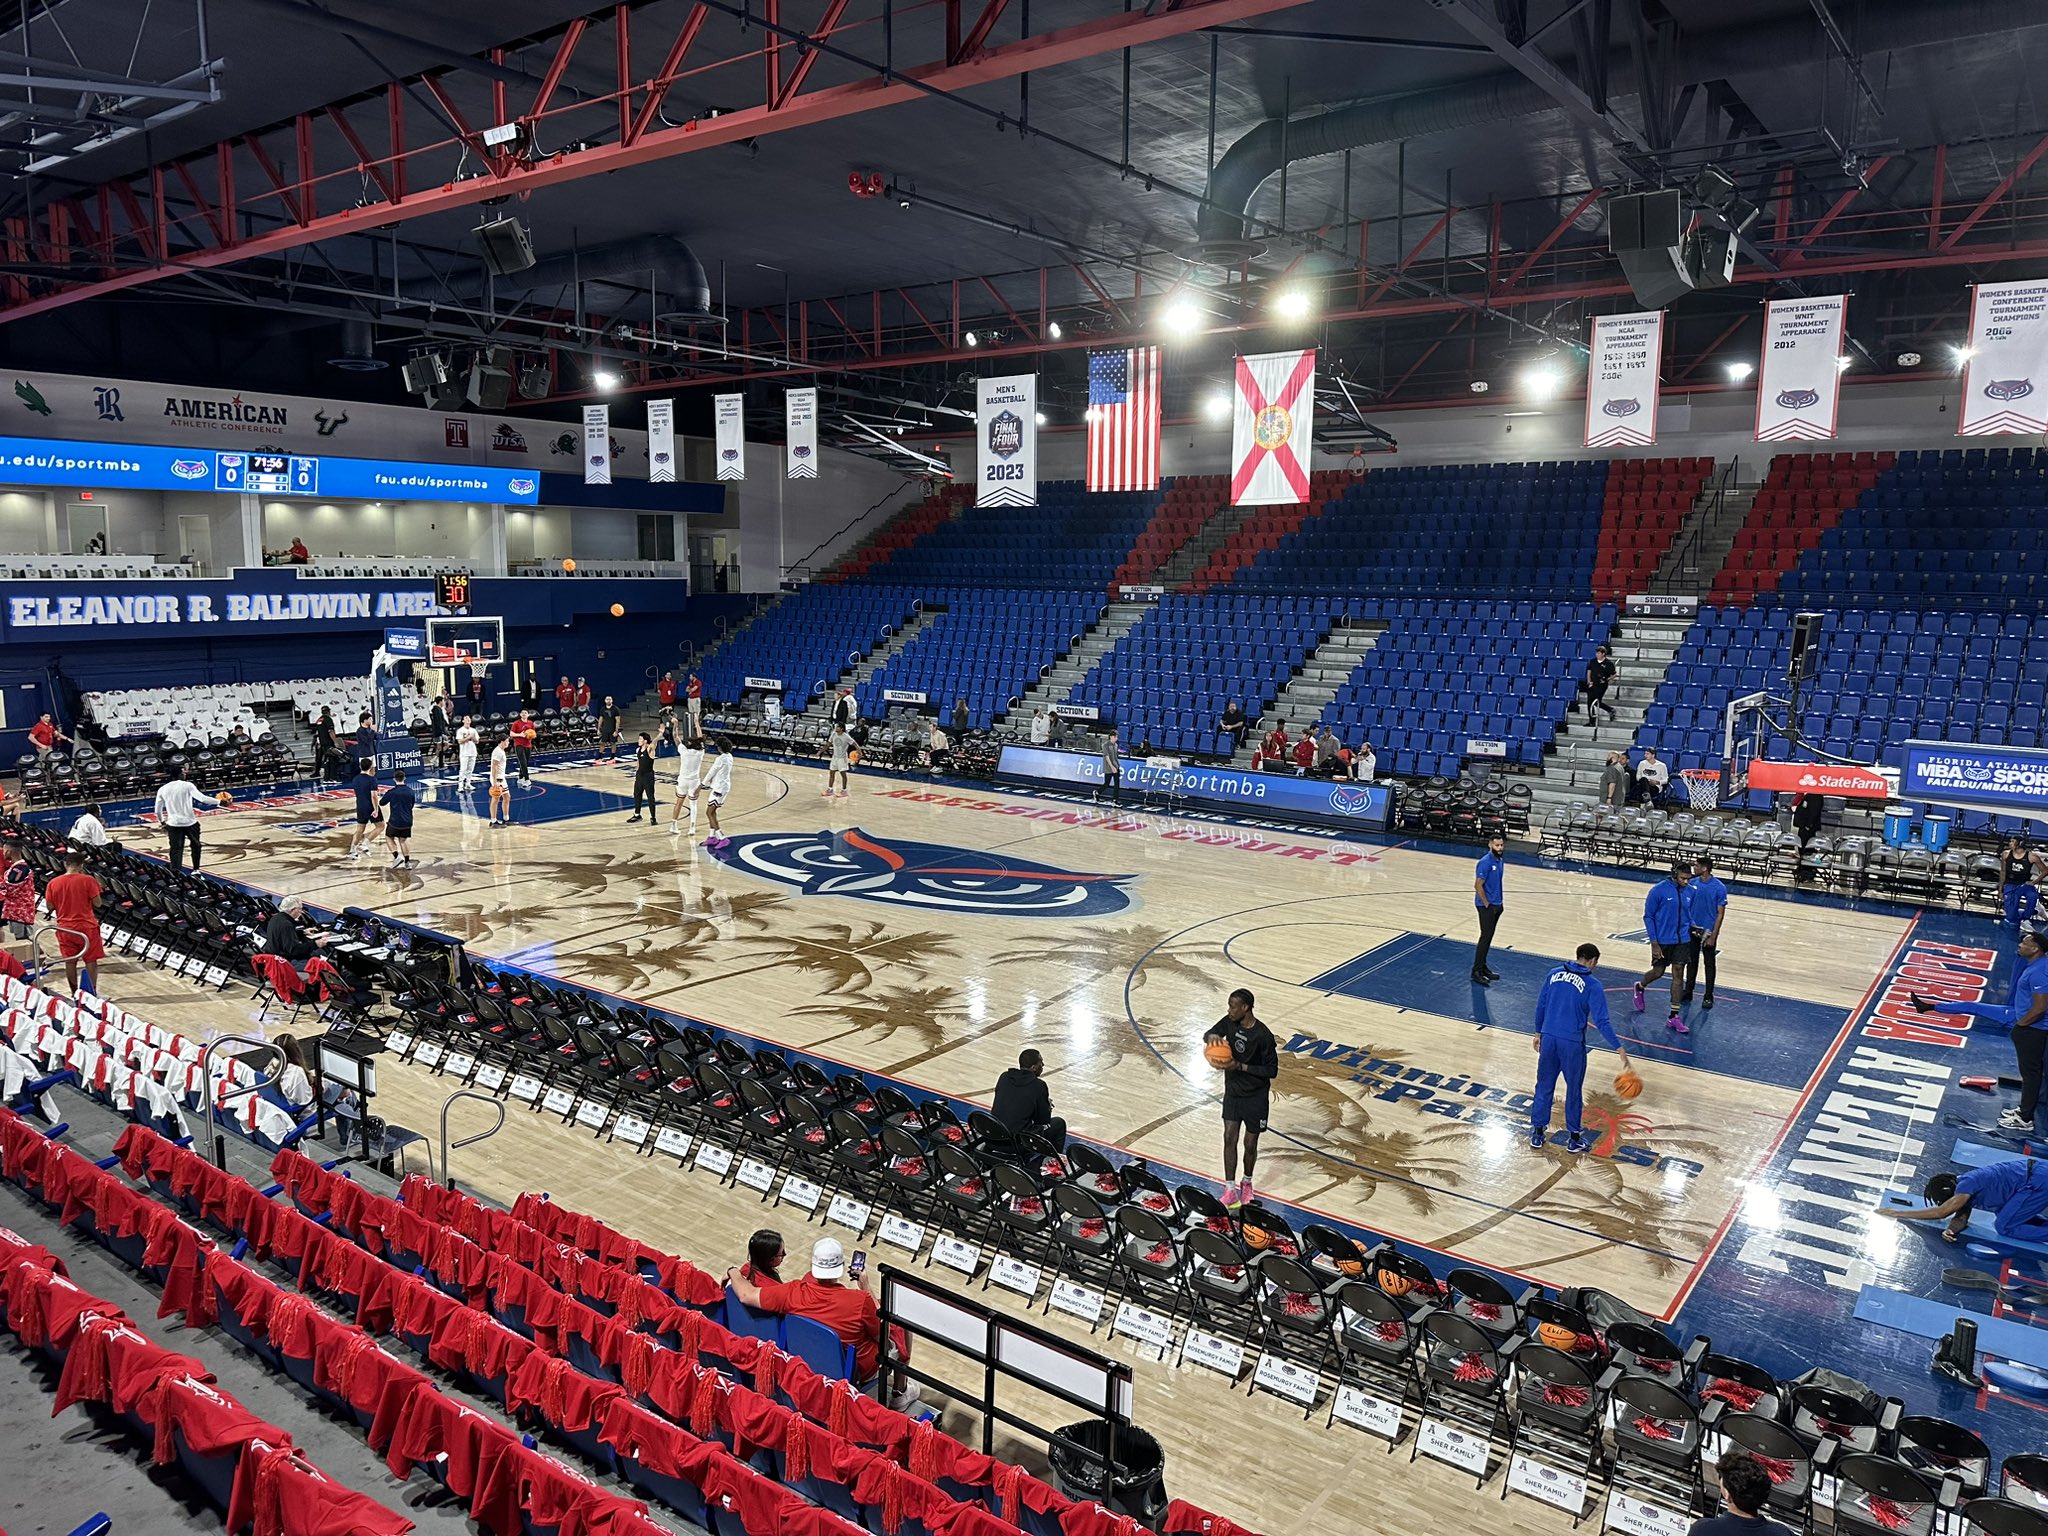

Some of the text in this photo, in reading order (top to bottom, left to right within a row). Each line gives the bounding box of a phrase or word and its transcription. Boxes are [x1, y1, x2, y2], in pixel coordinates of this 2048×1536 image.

[1992, 296, 2044, 306] CONFERENCE
[1771, 303, 1841, 314] WOMEN'S BASKETBALL
[1989, 304, 2046, 314] TOURNAMENT
[1993, 313, 2040, 322] CHAMPIONS
[1780, 320, 1829, 329] TOURNAMENT
[1605, 333, 1648, 342] TOURNAMENT
[1781, 328, 1826, 337] APPEARANCE
[1606, 341, 1646, 349] APPEARANCE
[1774, 341, 1796, 349] 2012
[986, 394, 1026, 405] BASKETBALL
[163, 397, 288, 426] AMERICAN
[170, 418, 284, 434] ATHLETIC CONFERENCE
[995, 422, 1018, 435] FINAL
[996, 434, 1019, 446] FOUR
[254, 456, 283, 469] 71:56
[226, 468, 237, 482] 0
[986, 464, 1024, 480] 2023
[299, 472, 309, 486] 0
[375, 472, 488, 490] fau.edu/sportmba
[441, 575, 468, 586] 71:56
[446, 586, 464, 603] 30
[1644, 596, 1678, 604] SECTION
[10, 595, 181, 627] ELEANOR
[187, 594, 220, 622] R.
[226, 592, 371, 622] BALDWIN
[1671, 606, 1679, 615] E
[750, 678, 771, 687] SECTION
[890, 691, 914, 700] SECTION
[1056, 706, 1084, 716] SECTION
[394, 750, 421, 761] Baptist
[1928, 756, 1981, 767] FLORIDA
[395, 759, 421, 769] Health
[1917, 763, 1963, 779] MBA
[1076, 757, 1266, 798] fauedu/sportmba
[1160, 829, 1383, 867] COURT
[1550, 971, 1586, 994] MEMPHIS
[1282, 1032, 1536, 1116] Winning
[898, 1233, 913, 1242] FAMILY
[953, 1254, 968, 1264] FAMILY
[1012, 1275, 1029, 1286] FAMILY
[1053, 1293, 1098, 1314] ROSEMURGY FAMILY
[1118, 1317, 1148, 1332] ROSEMURGY
[1147, 1329, 1166, 1339] FAMILY
[1187, 1344, 1220, 1361] ROSEMURGY
[1219, 1356, 1238, 1367] FAMILY
[1259, 1369, 1294, 1388] ROSEMURGY
[1293, 1383, 1313, 1395] FAMILY
[1345, 1404, 1364, 1415] SHER
[1364, 1409, 1389, 1425] FAMILY
[1430, 1437, 1449, 1450] SHER
[1449, 1445, 1476, 1460] FAMILY
[1524, 1478, 1543, 1489] SHER
[1543, 1484, 1568, 1499] FAMILY
[1623, 1515, 1643, 1528] SHER
[1643, 1523, 1671, 1536] FAMILY
